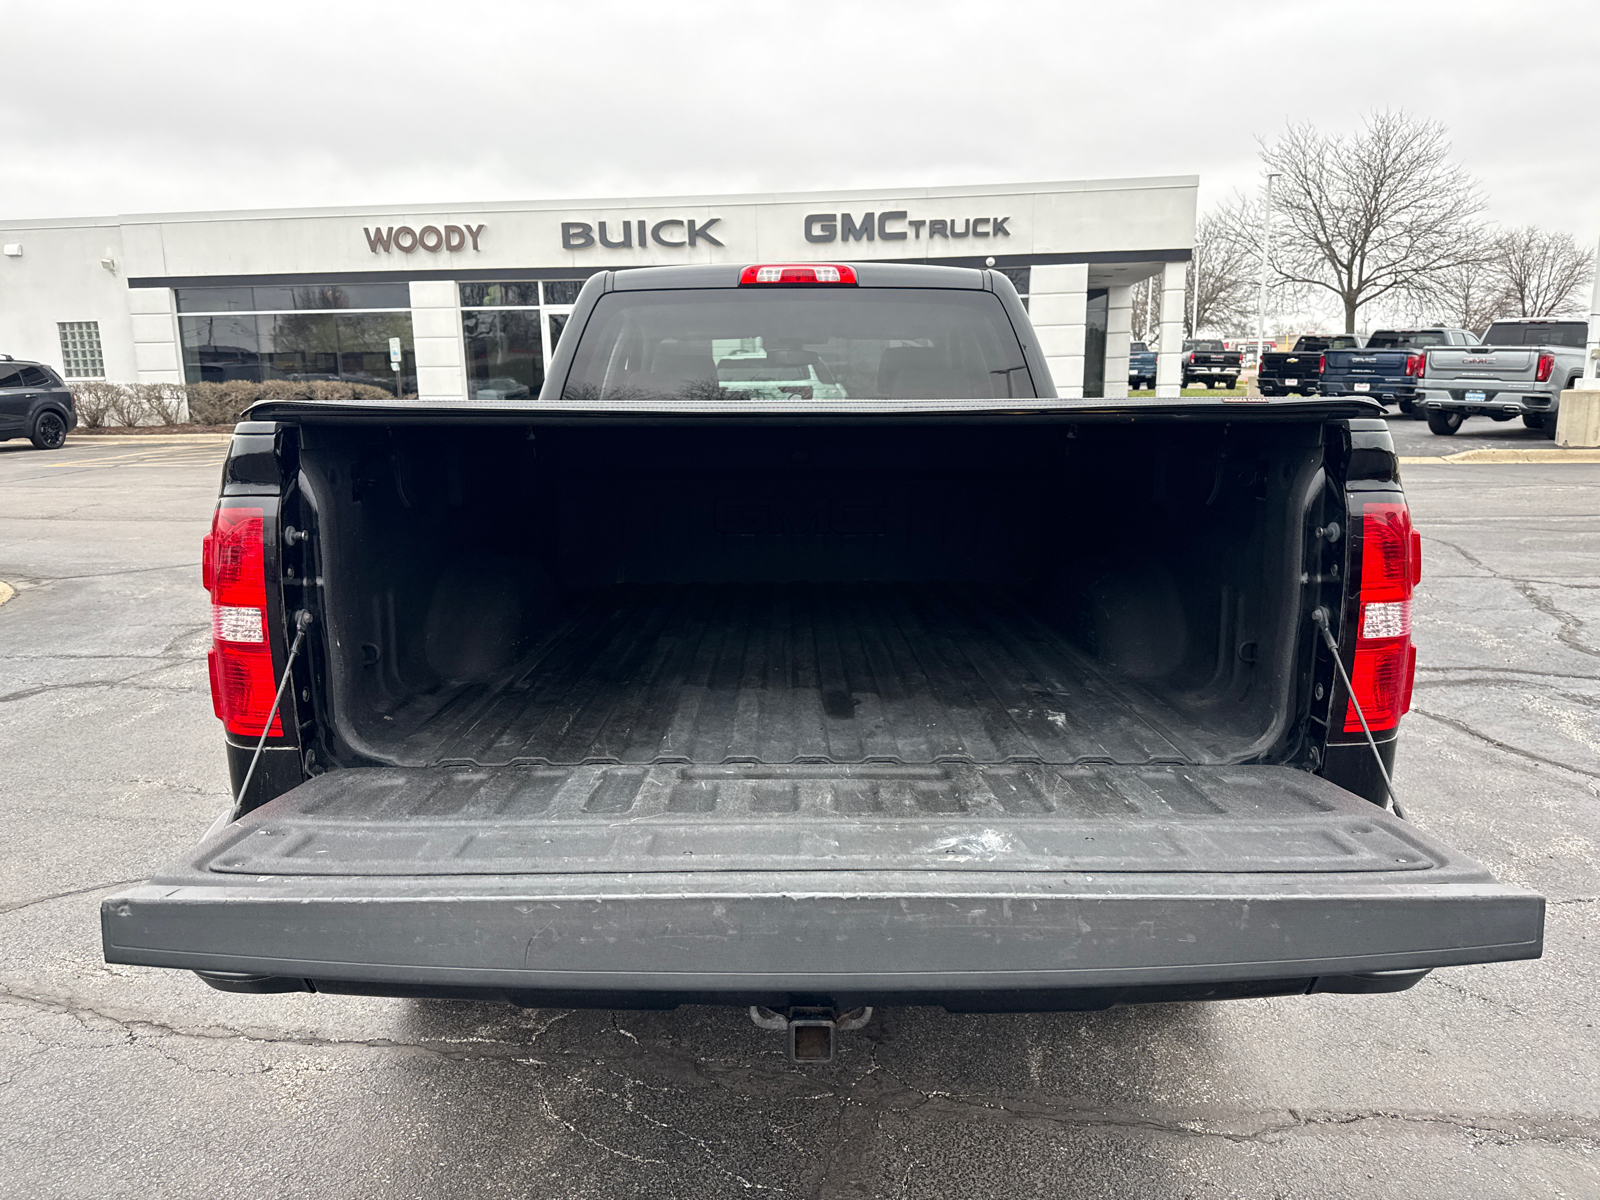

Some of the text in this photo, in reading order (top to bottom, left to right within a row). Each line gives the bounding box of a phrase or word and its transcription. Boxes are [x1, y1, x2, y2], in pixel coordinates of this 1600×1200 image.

[363, 224, 486, 254] WOODY
[561, 218, 725, 250] BUICK
[804, 210, 1011, 243] GMC TRUCK
